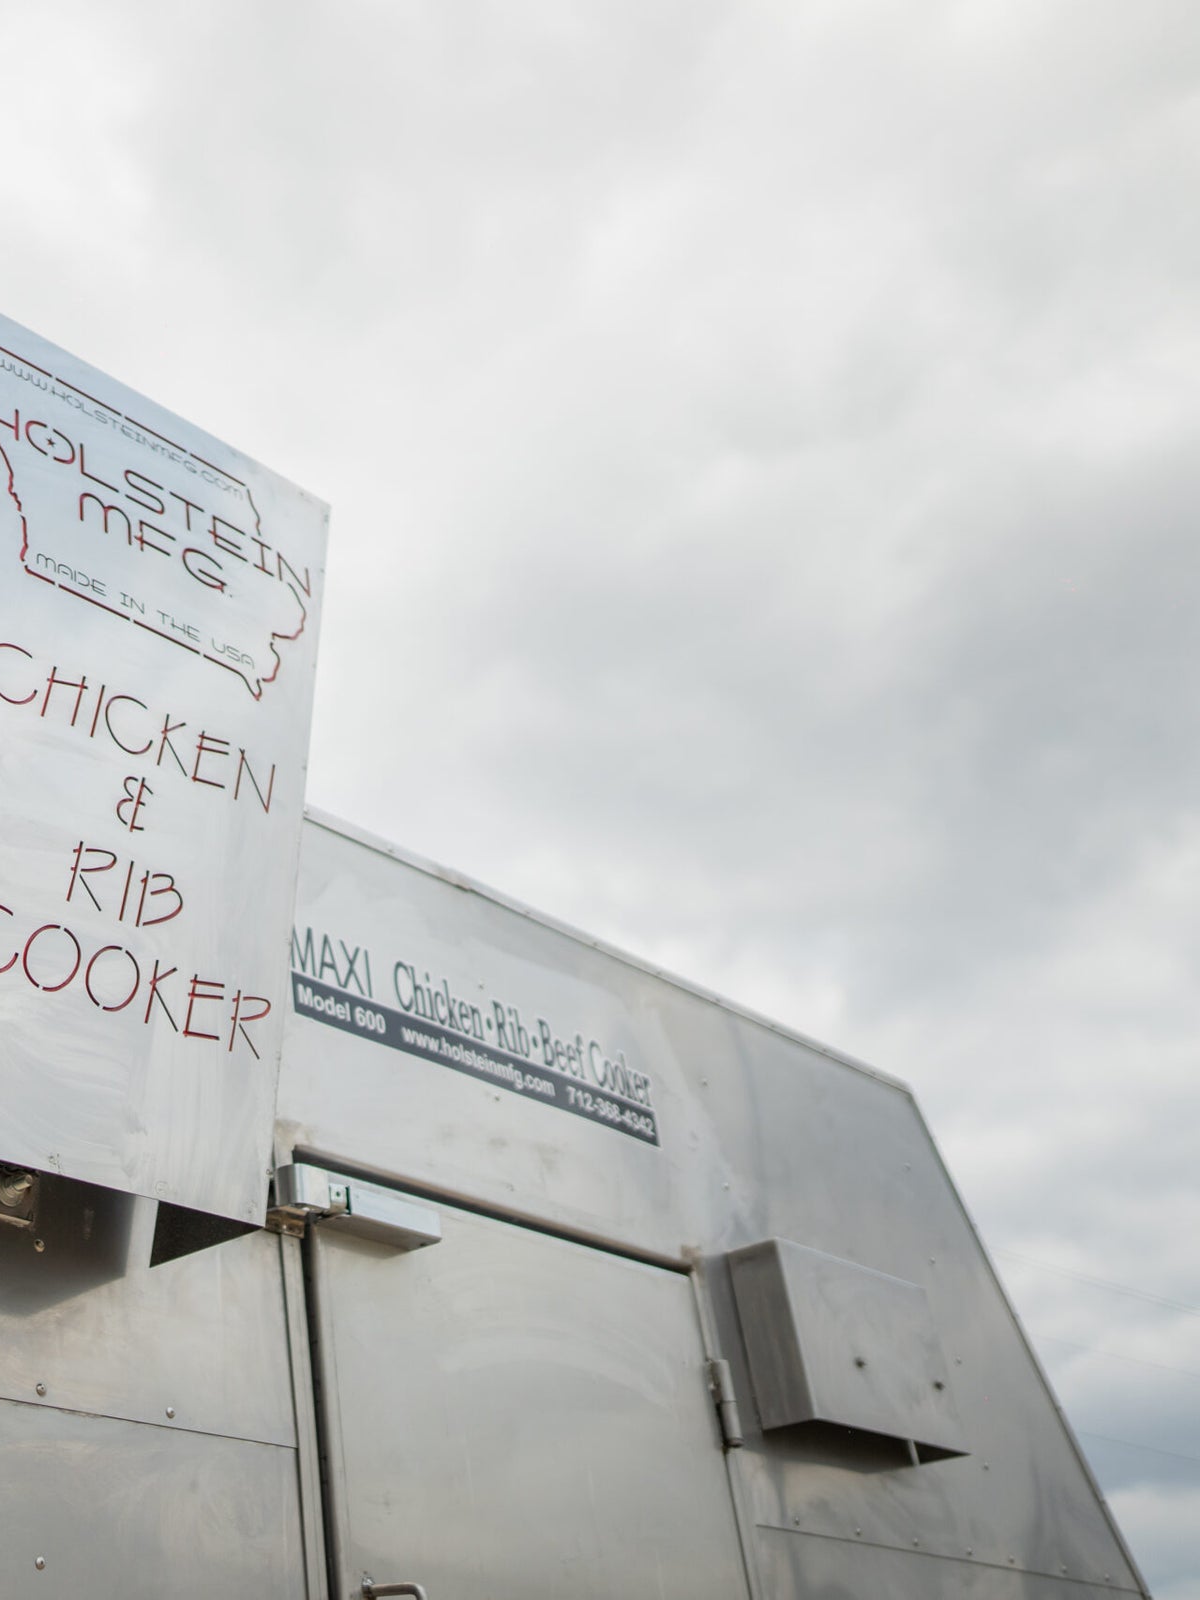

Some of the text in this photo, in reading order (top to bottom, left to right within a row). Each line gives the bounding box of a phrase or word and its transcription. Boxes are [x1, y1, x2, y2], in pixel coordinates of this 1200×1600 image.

[36, 553, 255, 669] MADE IN THE USA
[116, 776, 154, 832] &
[66, 841, 183, 927] RIB
[291, 925, 373, 998] MAXI
[588, 1040, 652, 1107] Cooker
[297, 983, 351, 1022] Model
[354, 1006, 386, 1034] 600
[402, 1025, 556, 1097] www.holsteinmfg.com
